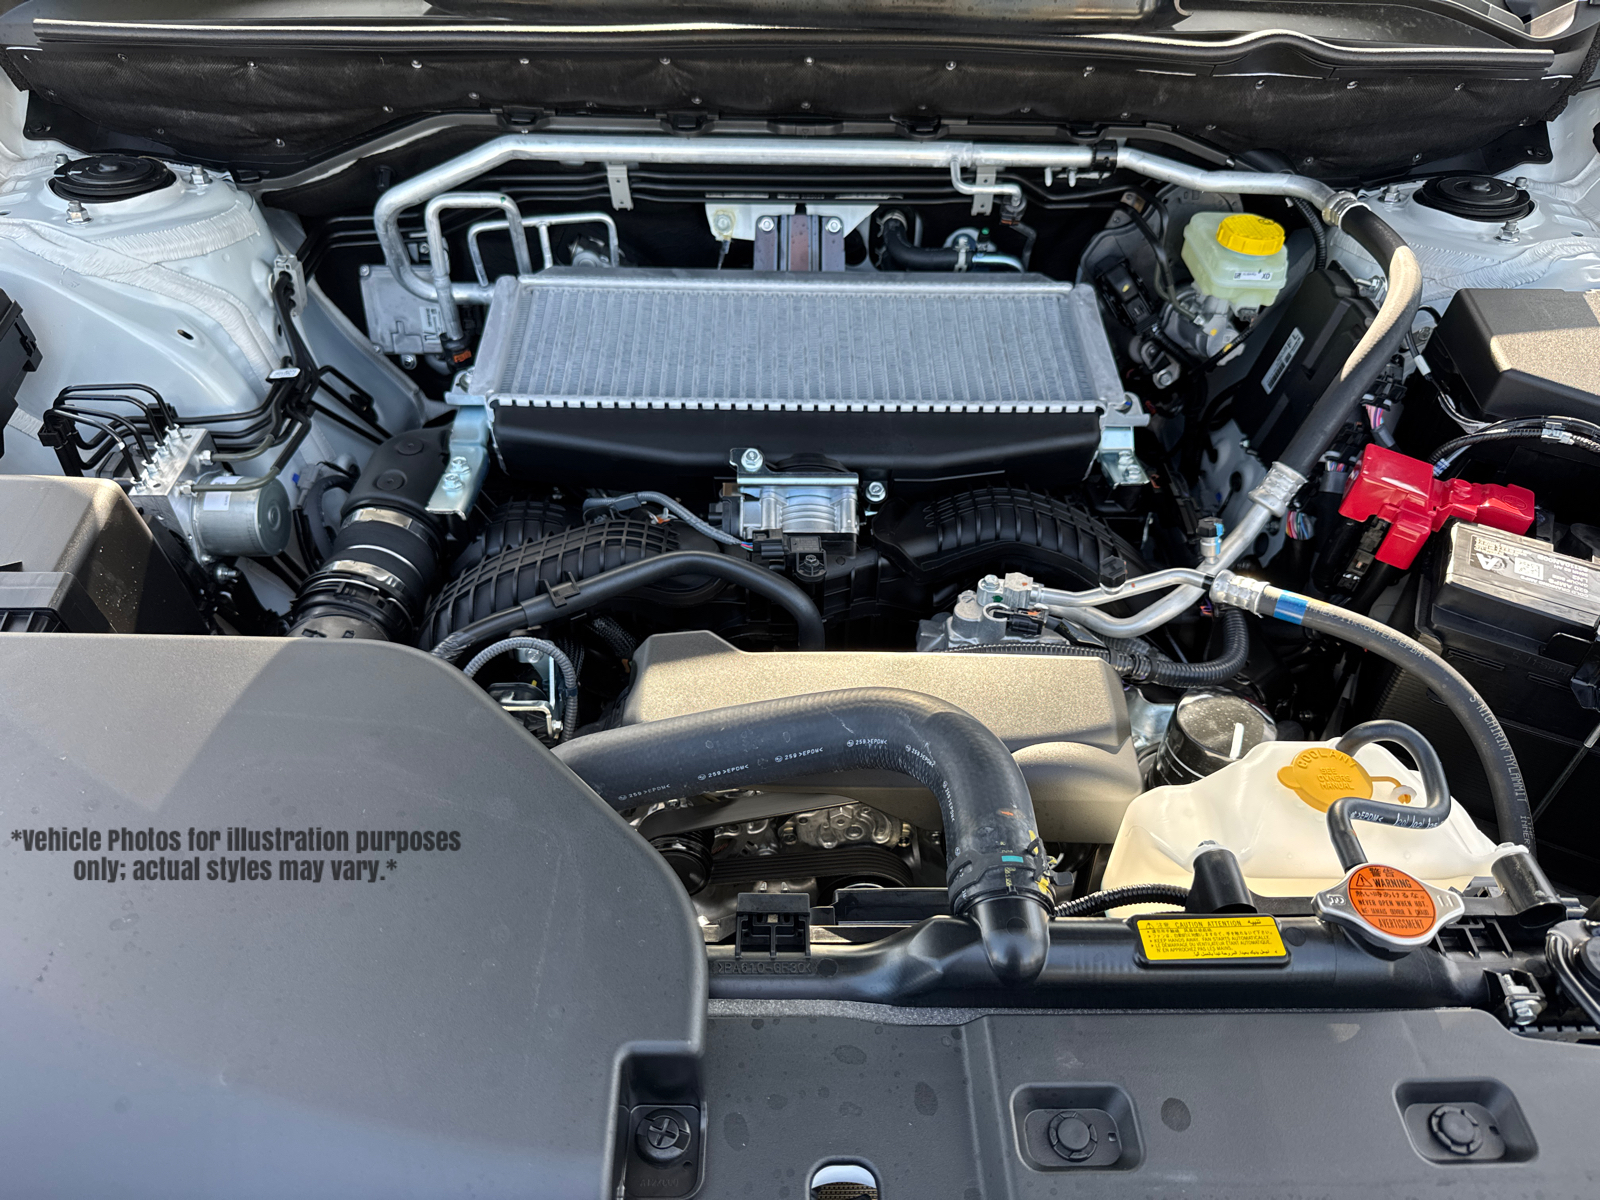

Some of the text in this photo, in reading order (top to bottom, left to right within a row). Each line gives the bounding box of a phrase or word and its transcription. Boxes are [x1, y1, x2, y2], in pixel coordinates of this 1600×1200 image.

[1296, 749, 1358, 770] COOLANT
[1319, 767, 1338, 776] SEE
[1317, 774, 1352, 783] OWNERS
[1319, 782, 1356, 791] MANUAL
[1372, 878, 1412, 888] WARNING
